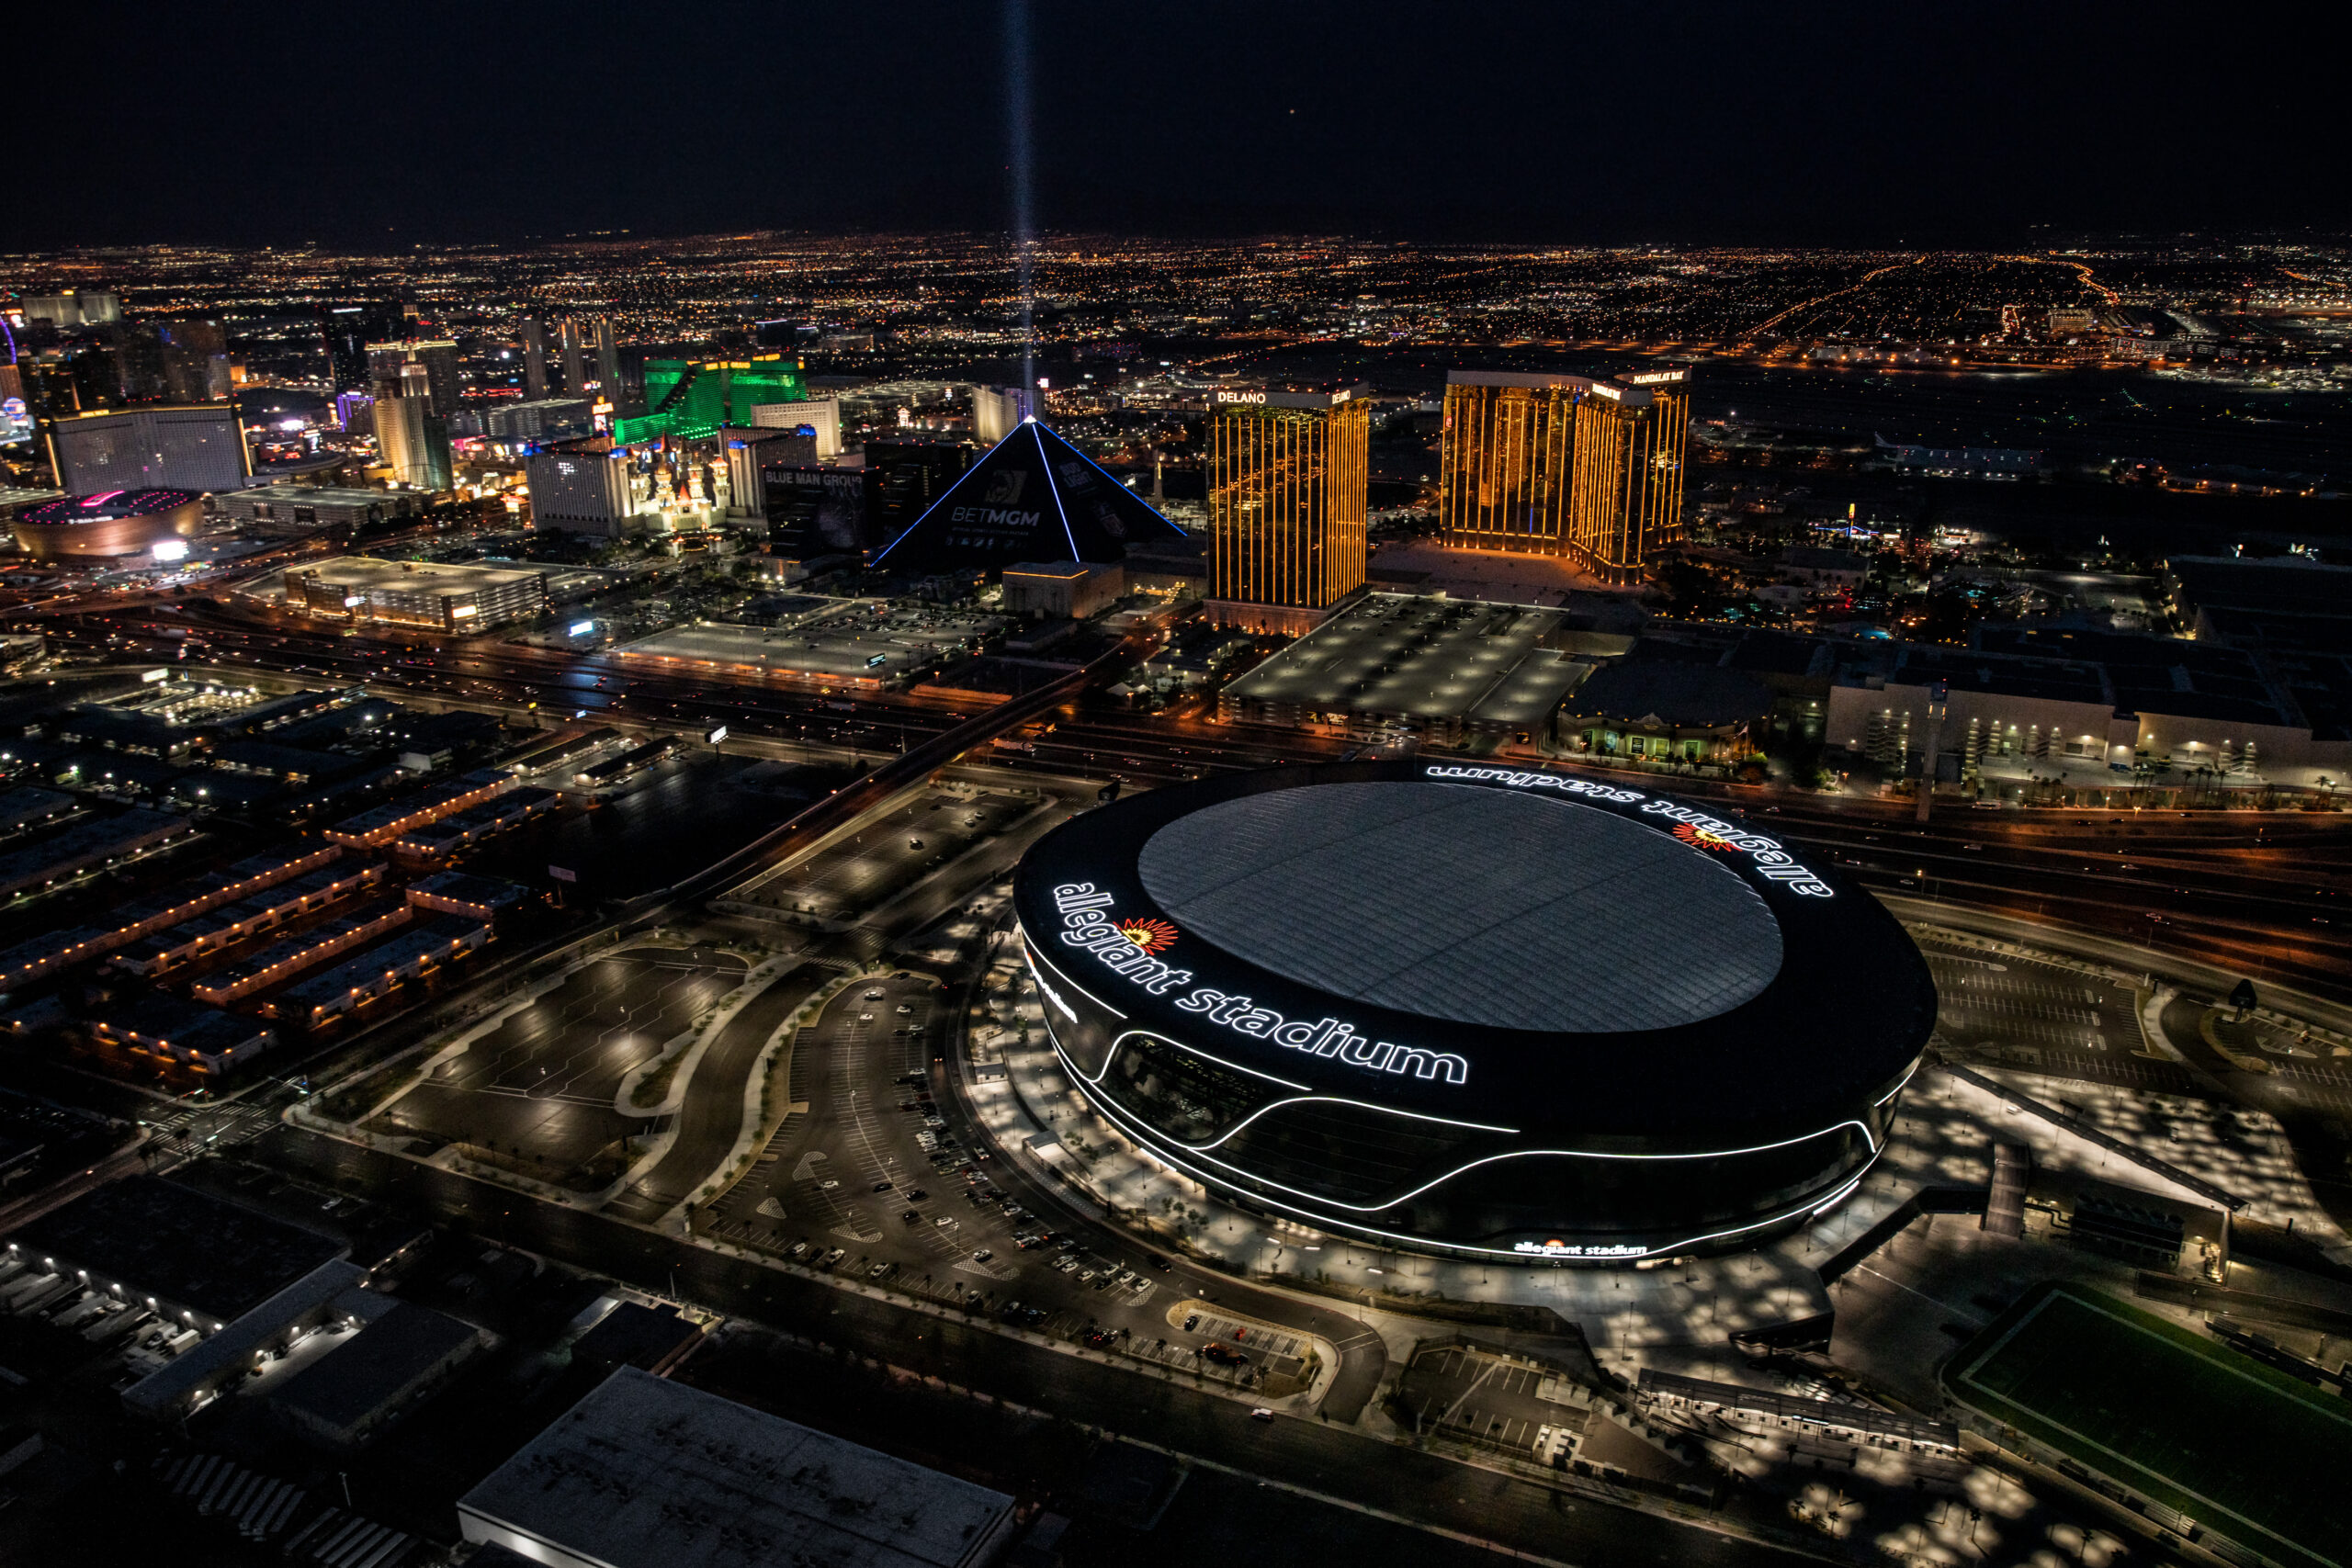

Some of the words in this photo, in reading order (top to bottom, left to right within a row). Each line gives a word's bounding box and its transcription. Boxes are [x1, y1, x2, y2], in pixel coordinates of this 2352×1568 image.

[1634, 373, 1670, 384] MANDALAY
[1217, 391, 1266, 404] DELANO
[765, 471, 793, 483] BLUE
[796, 472, 820, 485] MAN
[951, 506, 1040, 526] BETMGM
[1427, 765, 1645, 803] stadium
[1641, 800, 1835, 897] allegiant
[1054, 883, 1193, 995] allegiant
[1175, 988, 1468, 1084] stadium
[1514, 1242, 1581, 1256] allegiant
[1585, 1245, 1647, 1256] stadium
